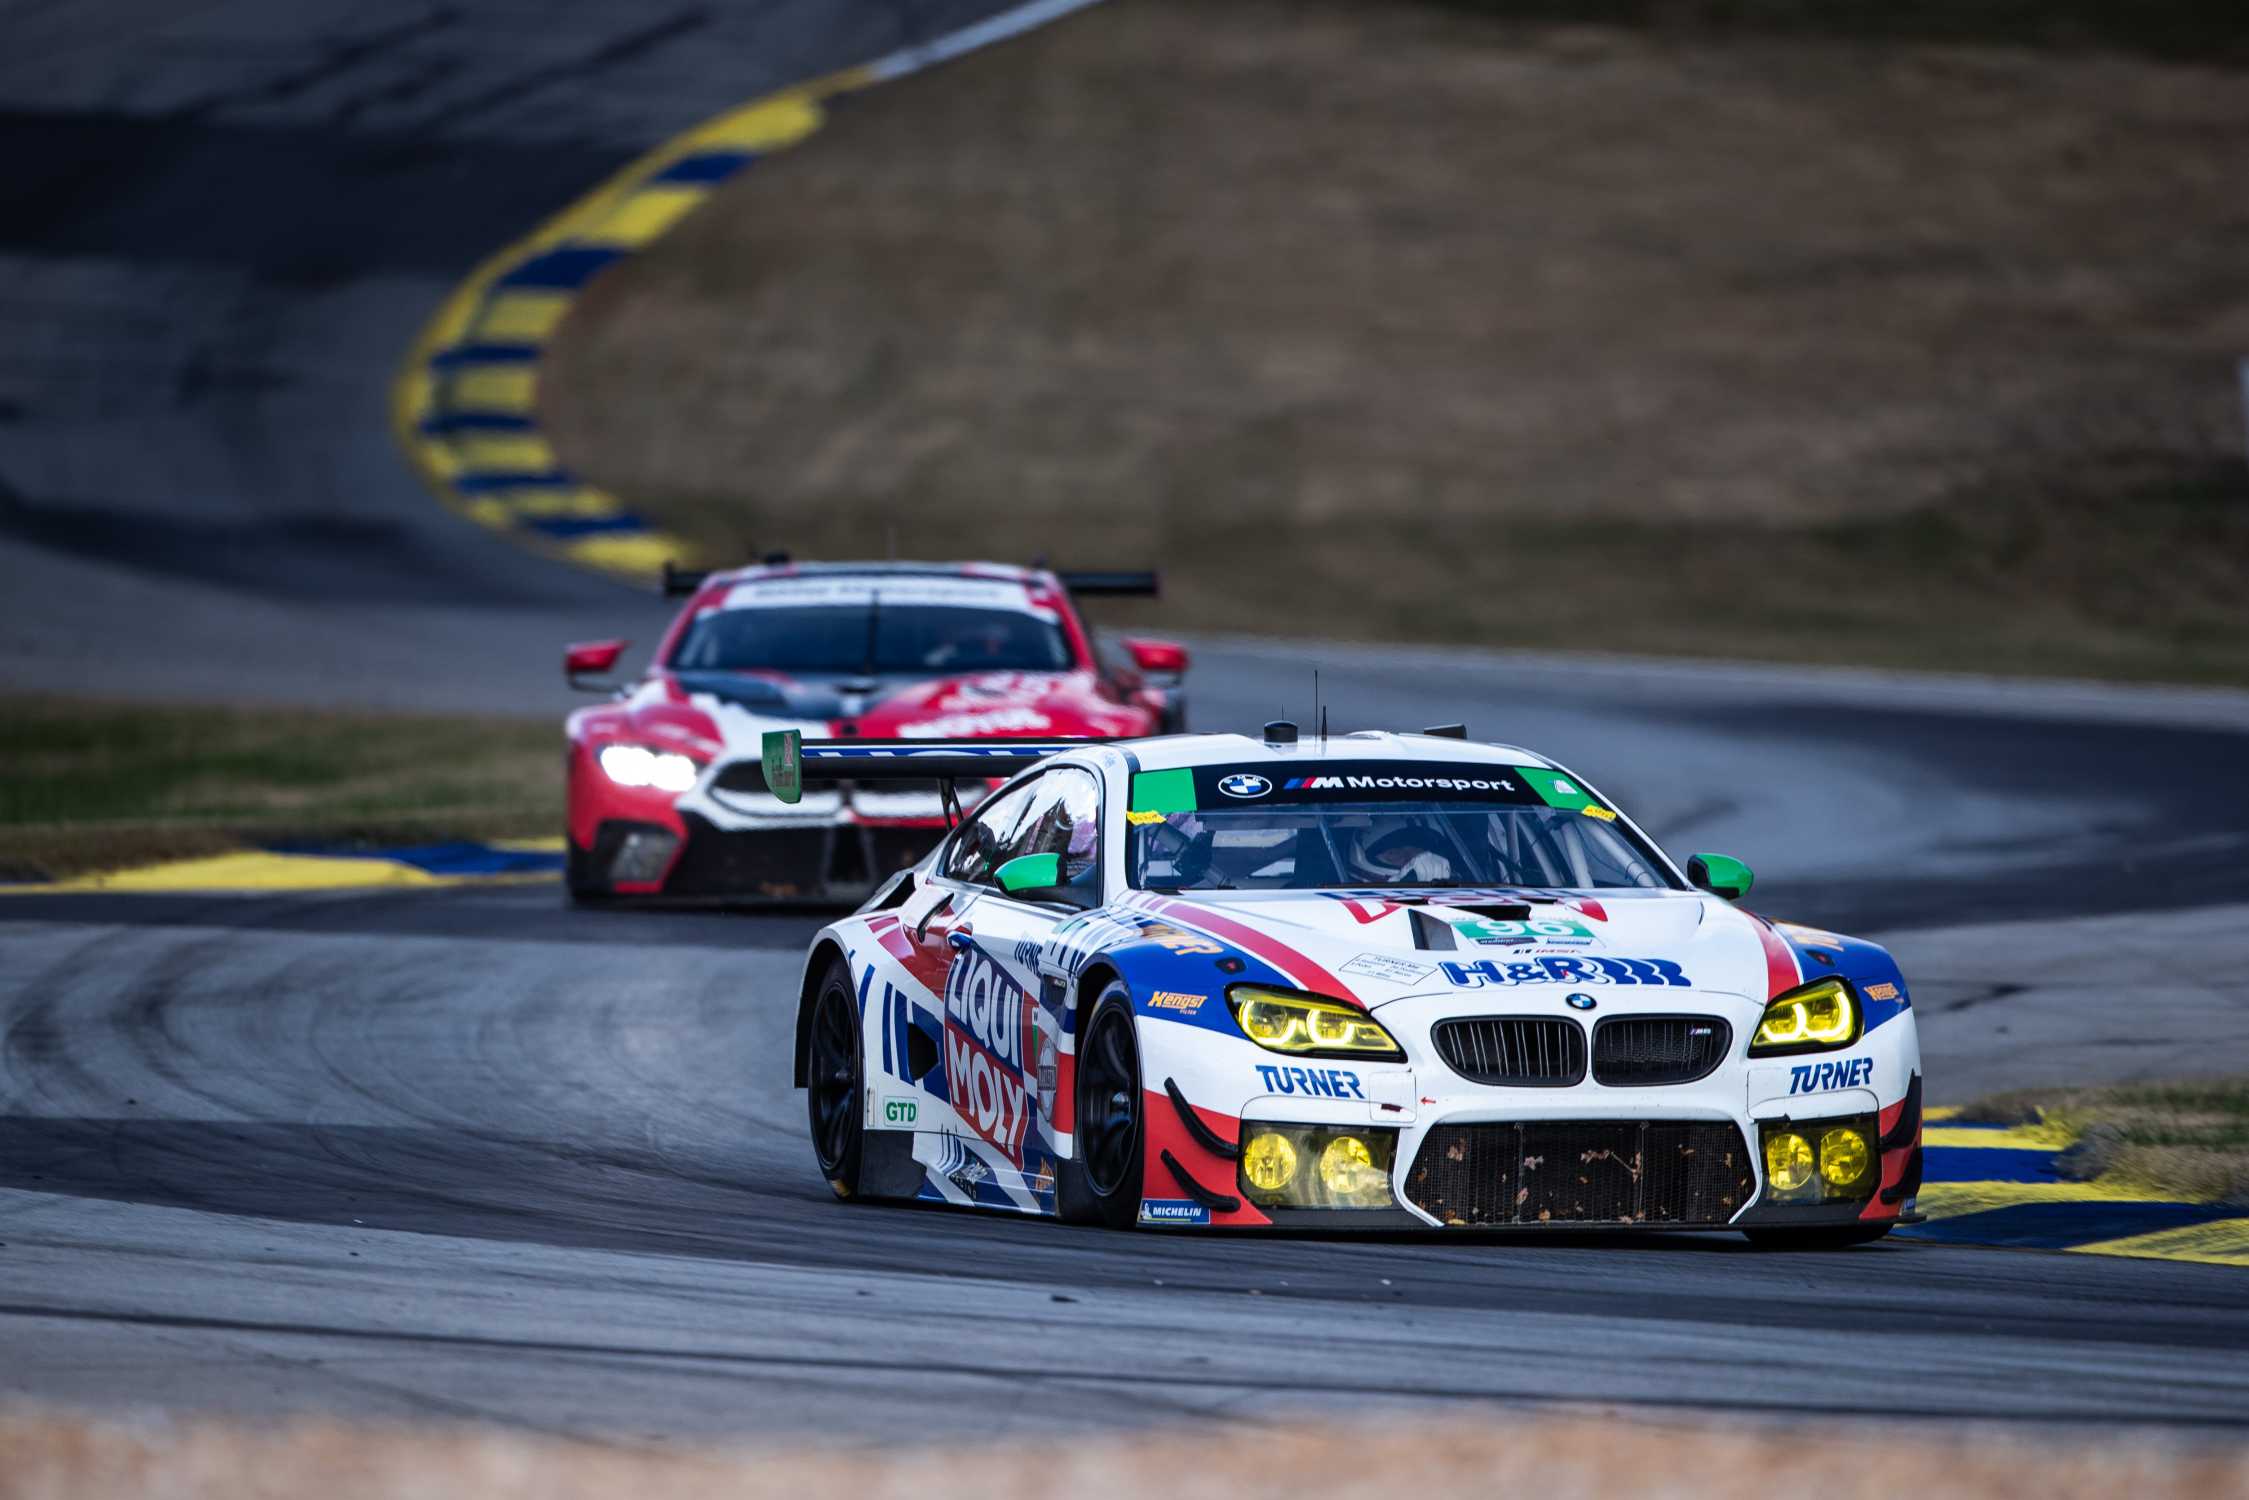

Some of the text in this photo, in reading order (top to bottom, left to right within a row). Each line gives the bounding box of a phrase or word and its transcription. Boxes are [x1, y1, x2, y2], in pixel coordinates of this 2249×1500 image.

[1350, 776, 1515, 791] Motorsport
[946, 949, 1019, 1068] LIQUI
[1148, 991, 1208, 1010] Hengst
[1255, 1064, 1365, 1099] TURNER
[1789, 1057, 1873, 1095] TURNER
[948, 1029, 1025, 1157] MOLY
[886, 1101, 917, 1122] GTD
[1152, 1206, 1201, 1217] MICHELIN
